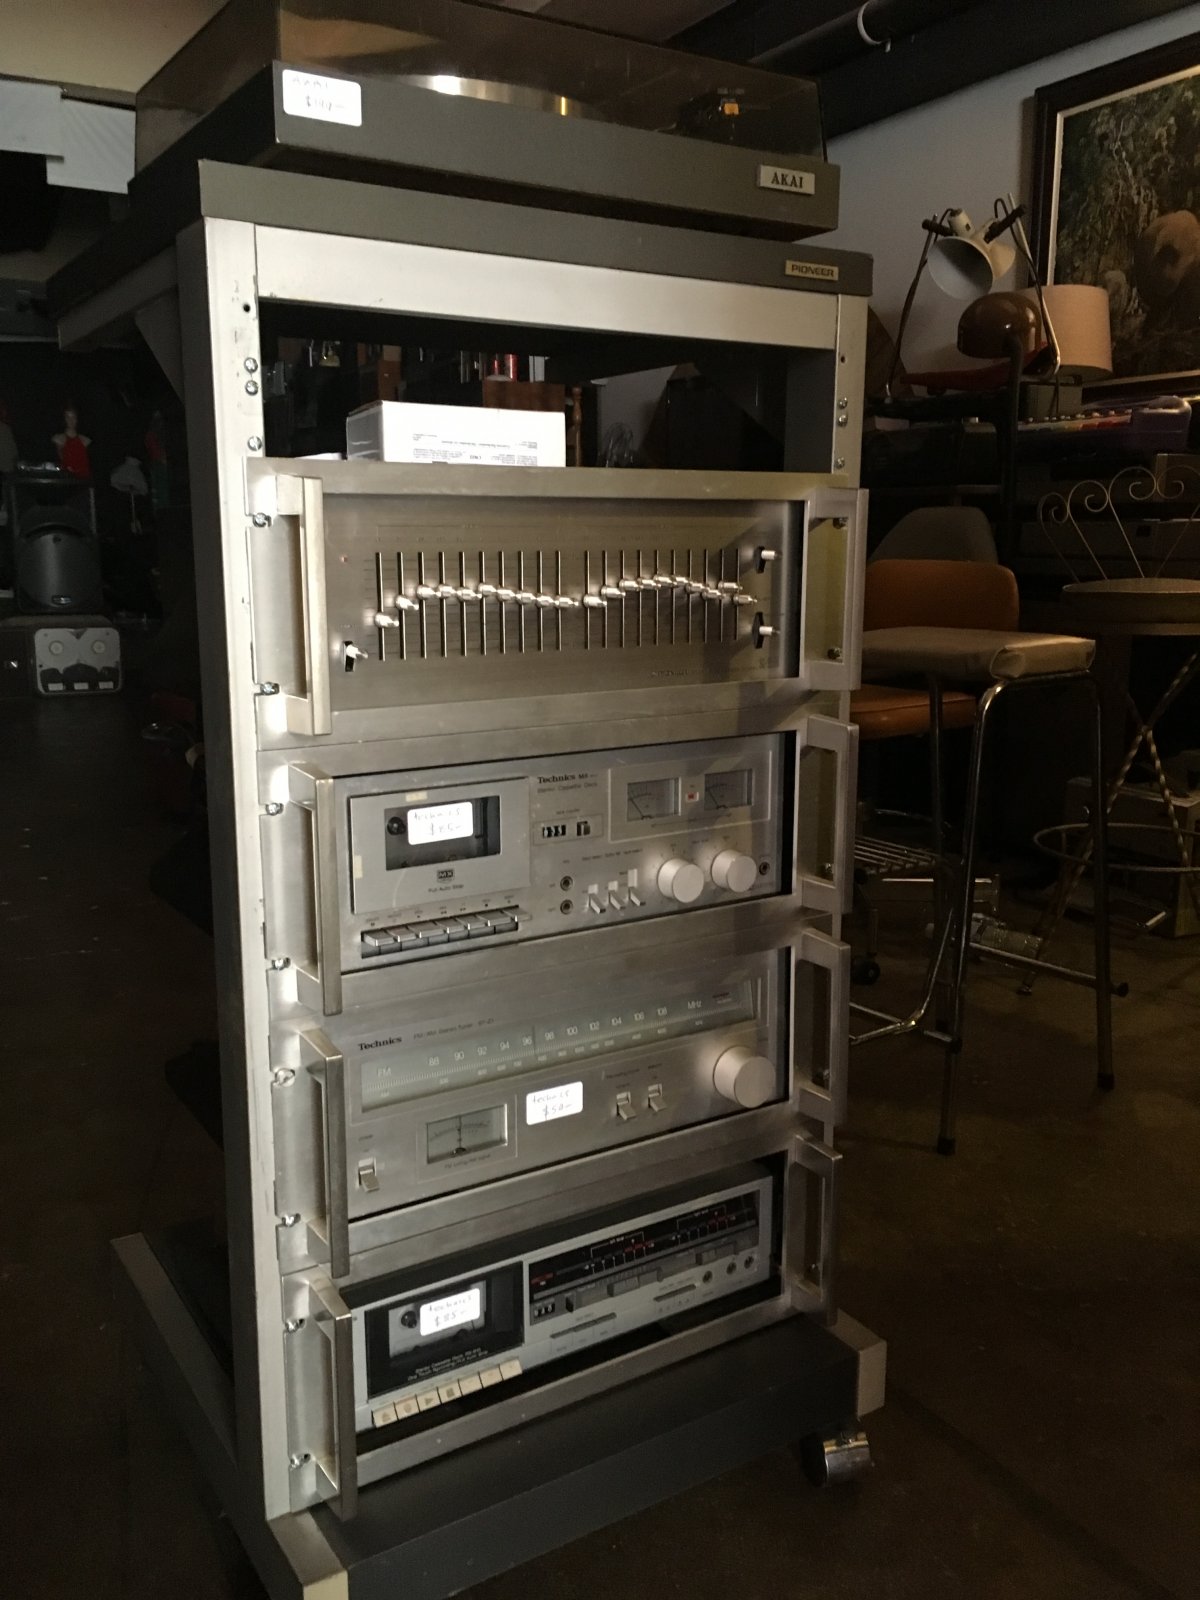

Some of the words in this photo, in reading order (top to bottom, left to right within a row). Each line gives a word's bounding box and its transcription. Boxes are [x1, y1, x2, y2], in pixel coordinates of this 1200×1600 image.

[771, 172, 803, 189] AKAI
[791, 264, 834, 277] PIONEER
[537, 773, 576, 784] Technics
[358, 1035, 402, 1052] Technics
[377, 1066, 392, 1078] FM
[428, 1056, 440, 1067] 88
[454, 1051, 465, 1062] 90
[477, 1046, 488, 1057] 92
[499, 1040, 510, 1051] 94
[521, 1035, 533, 1047] 96
[544, 1031, 555, 1042] 98
[566, 1026, 579, 1037] 100
[589, 1020, 600, 1032] 102
[611, 1016, 623, 1027] 104
